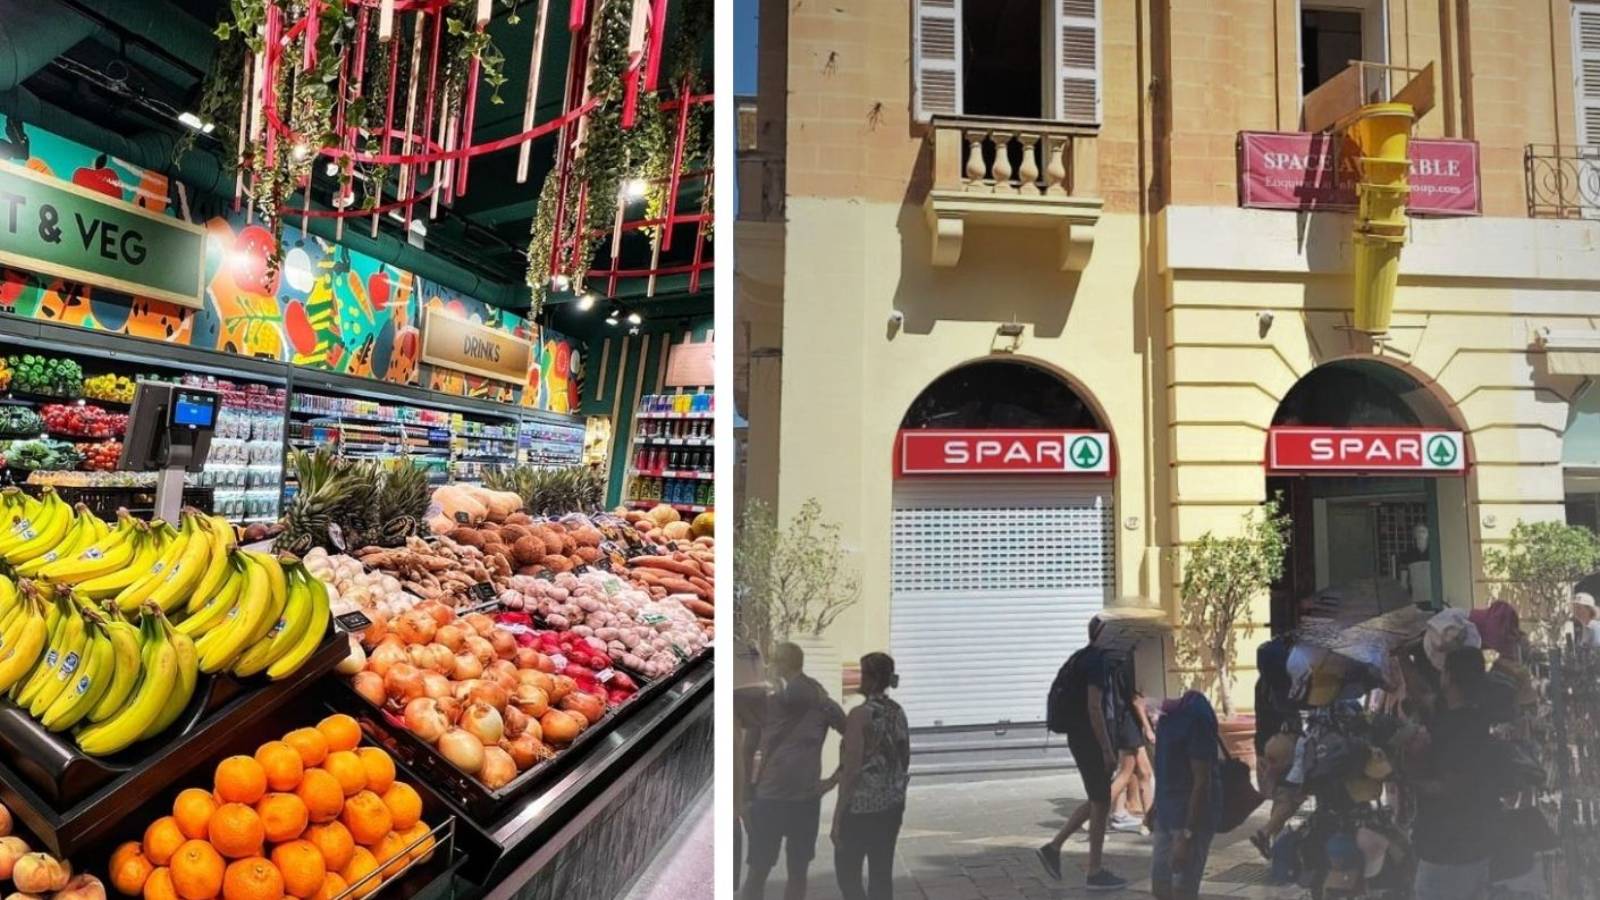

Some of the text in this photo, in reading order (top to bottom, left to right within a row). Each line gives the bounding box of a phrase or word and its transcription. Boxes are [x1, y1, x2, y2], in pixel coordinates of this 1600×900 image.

[1263, 151, 1332, 172] SPACE
[38, 204, 62, 244] &
[75, 213, 147, 265] VEG
[464, 335, 501, 362] DRINKS
[944, 440, 1062, 464] SPAR
[1310, 438, 1418, 461] SPAR
